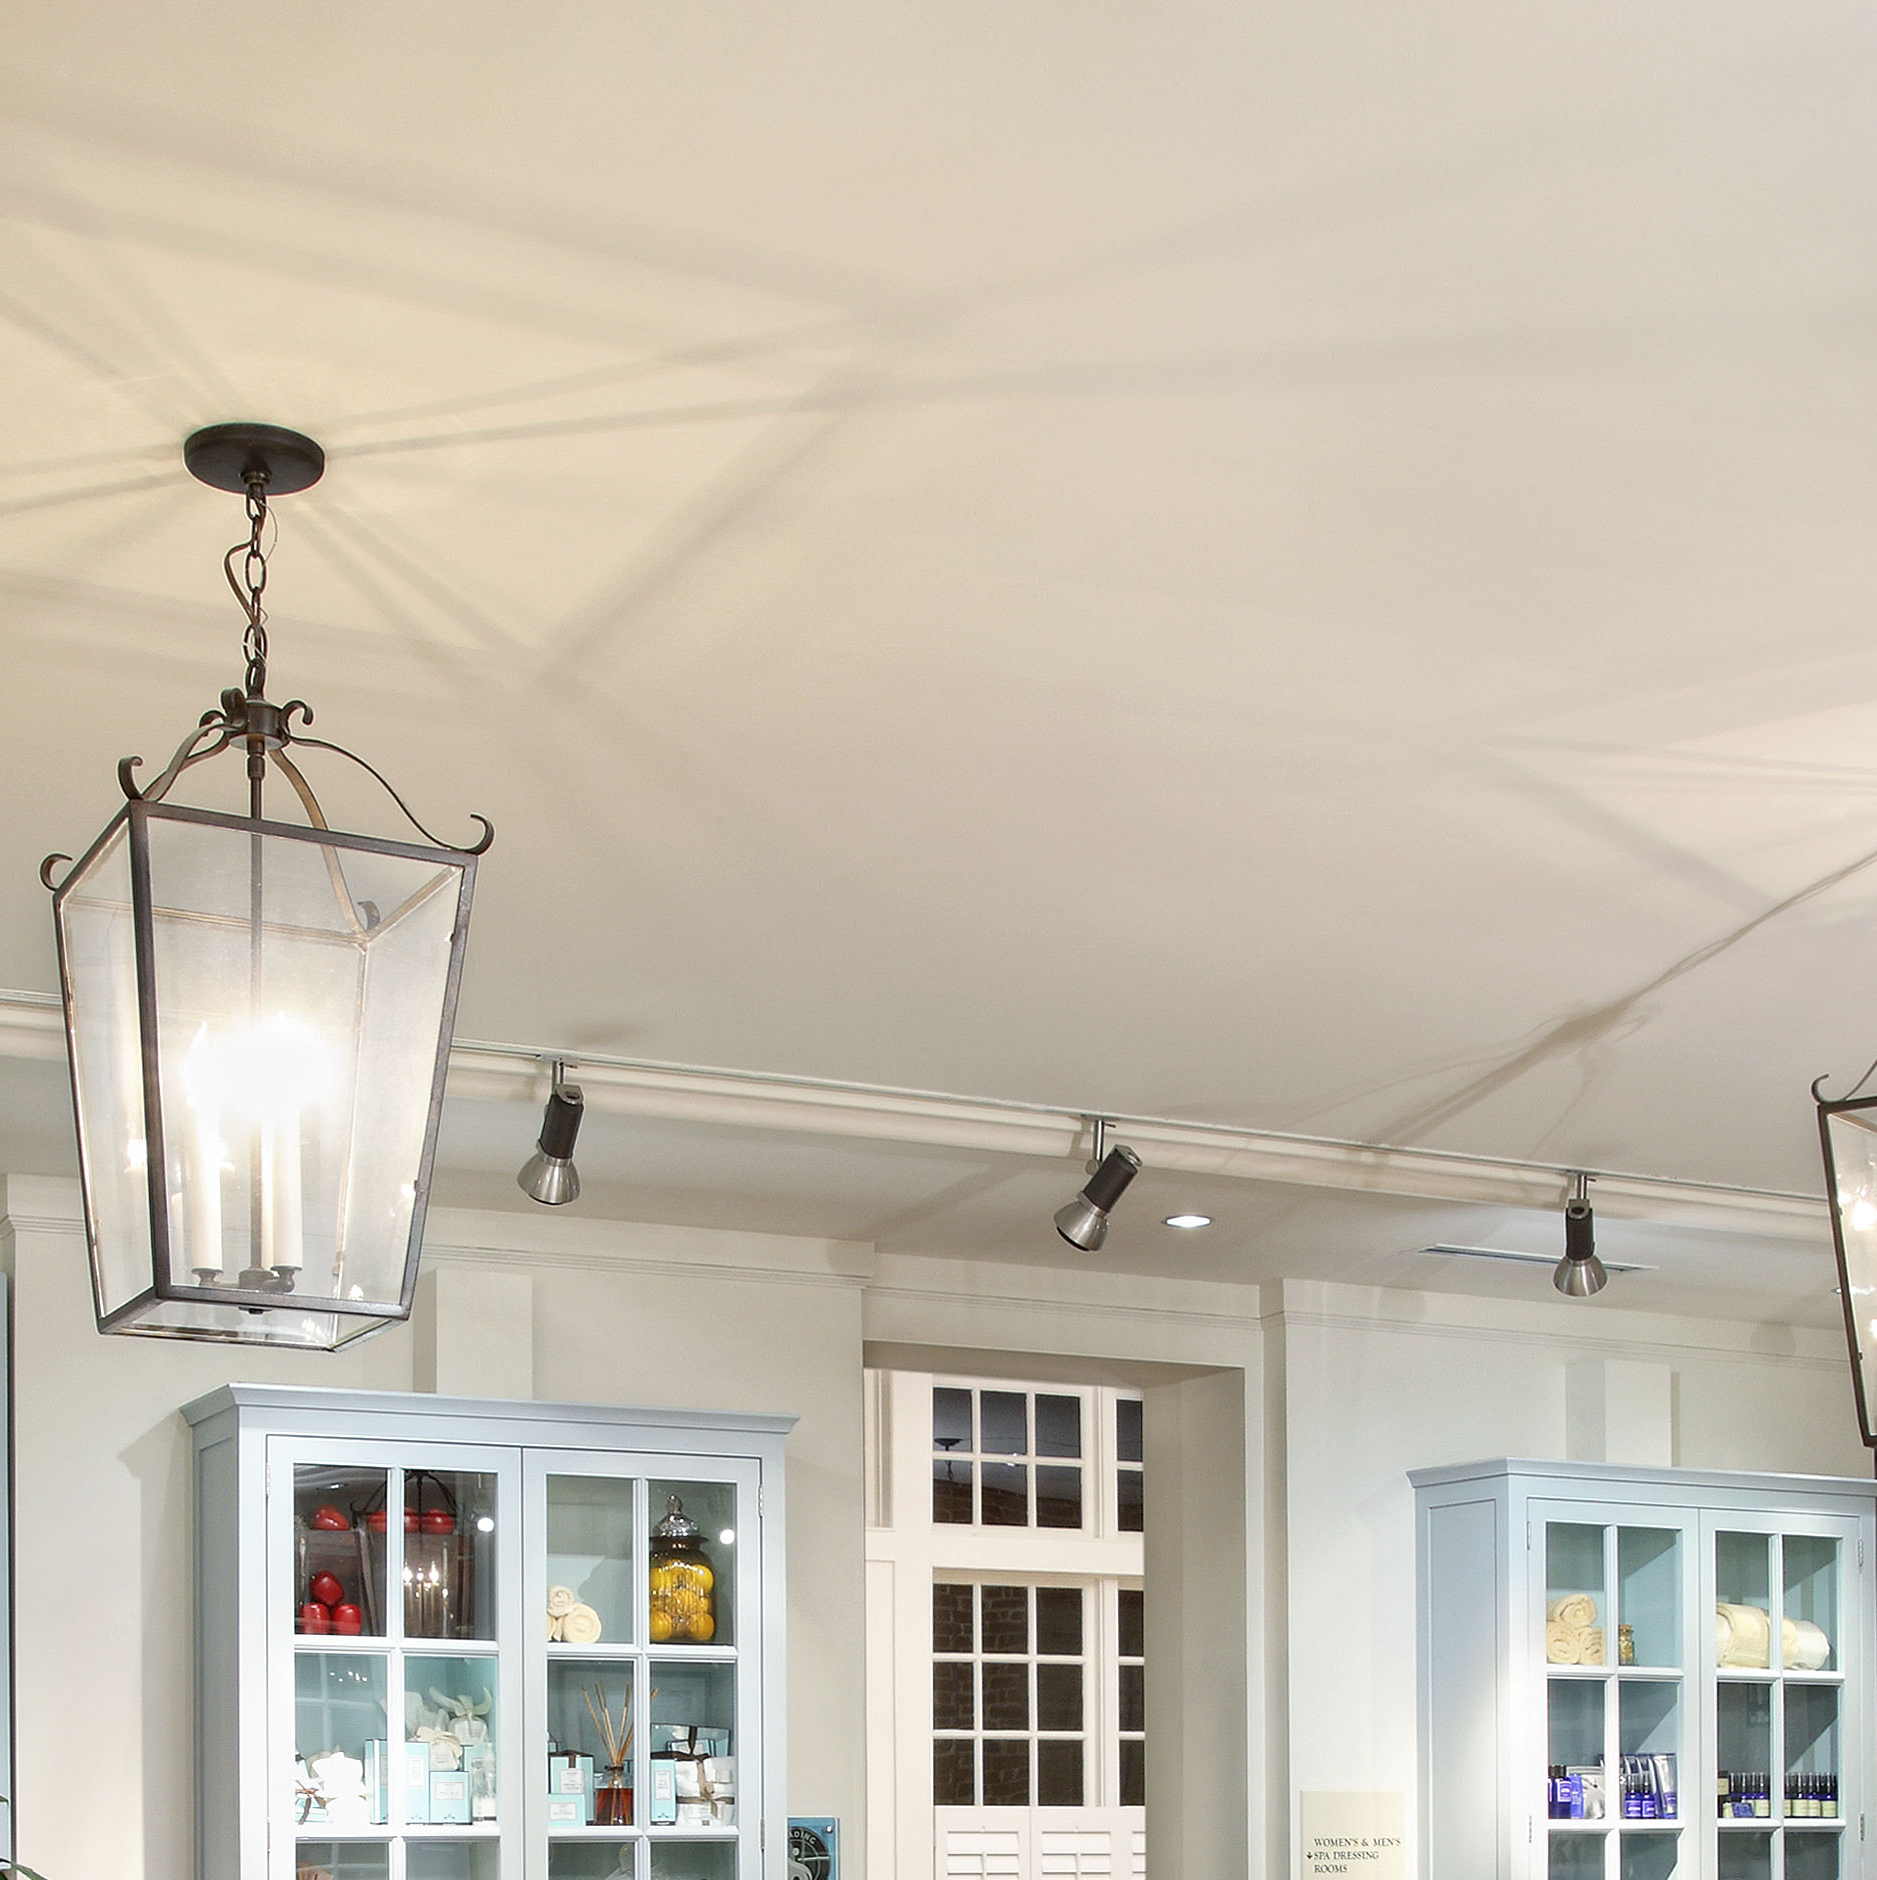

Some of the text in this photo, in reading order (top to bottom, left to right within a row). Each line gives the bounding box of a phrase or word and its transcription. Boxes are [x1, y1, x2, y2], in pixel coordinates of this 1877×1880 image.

[789, 1831, 816, 1844] ADING
[1314, 1838, 1401, 1846] WOMEN'S & MEN'S
[1314, 1851, 1379, 1860] SPA DRESSING
[1314, 1864, 1348, 1873] ROOMS
